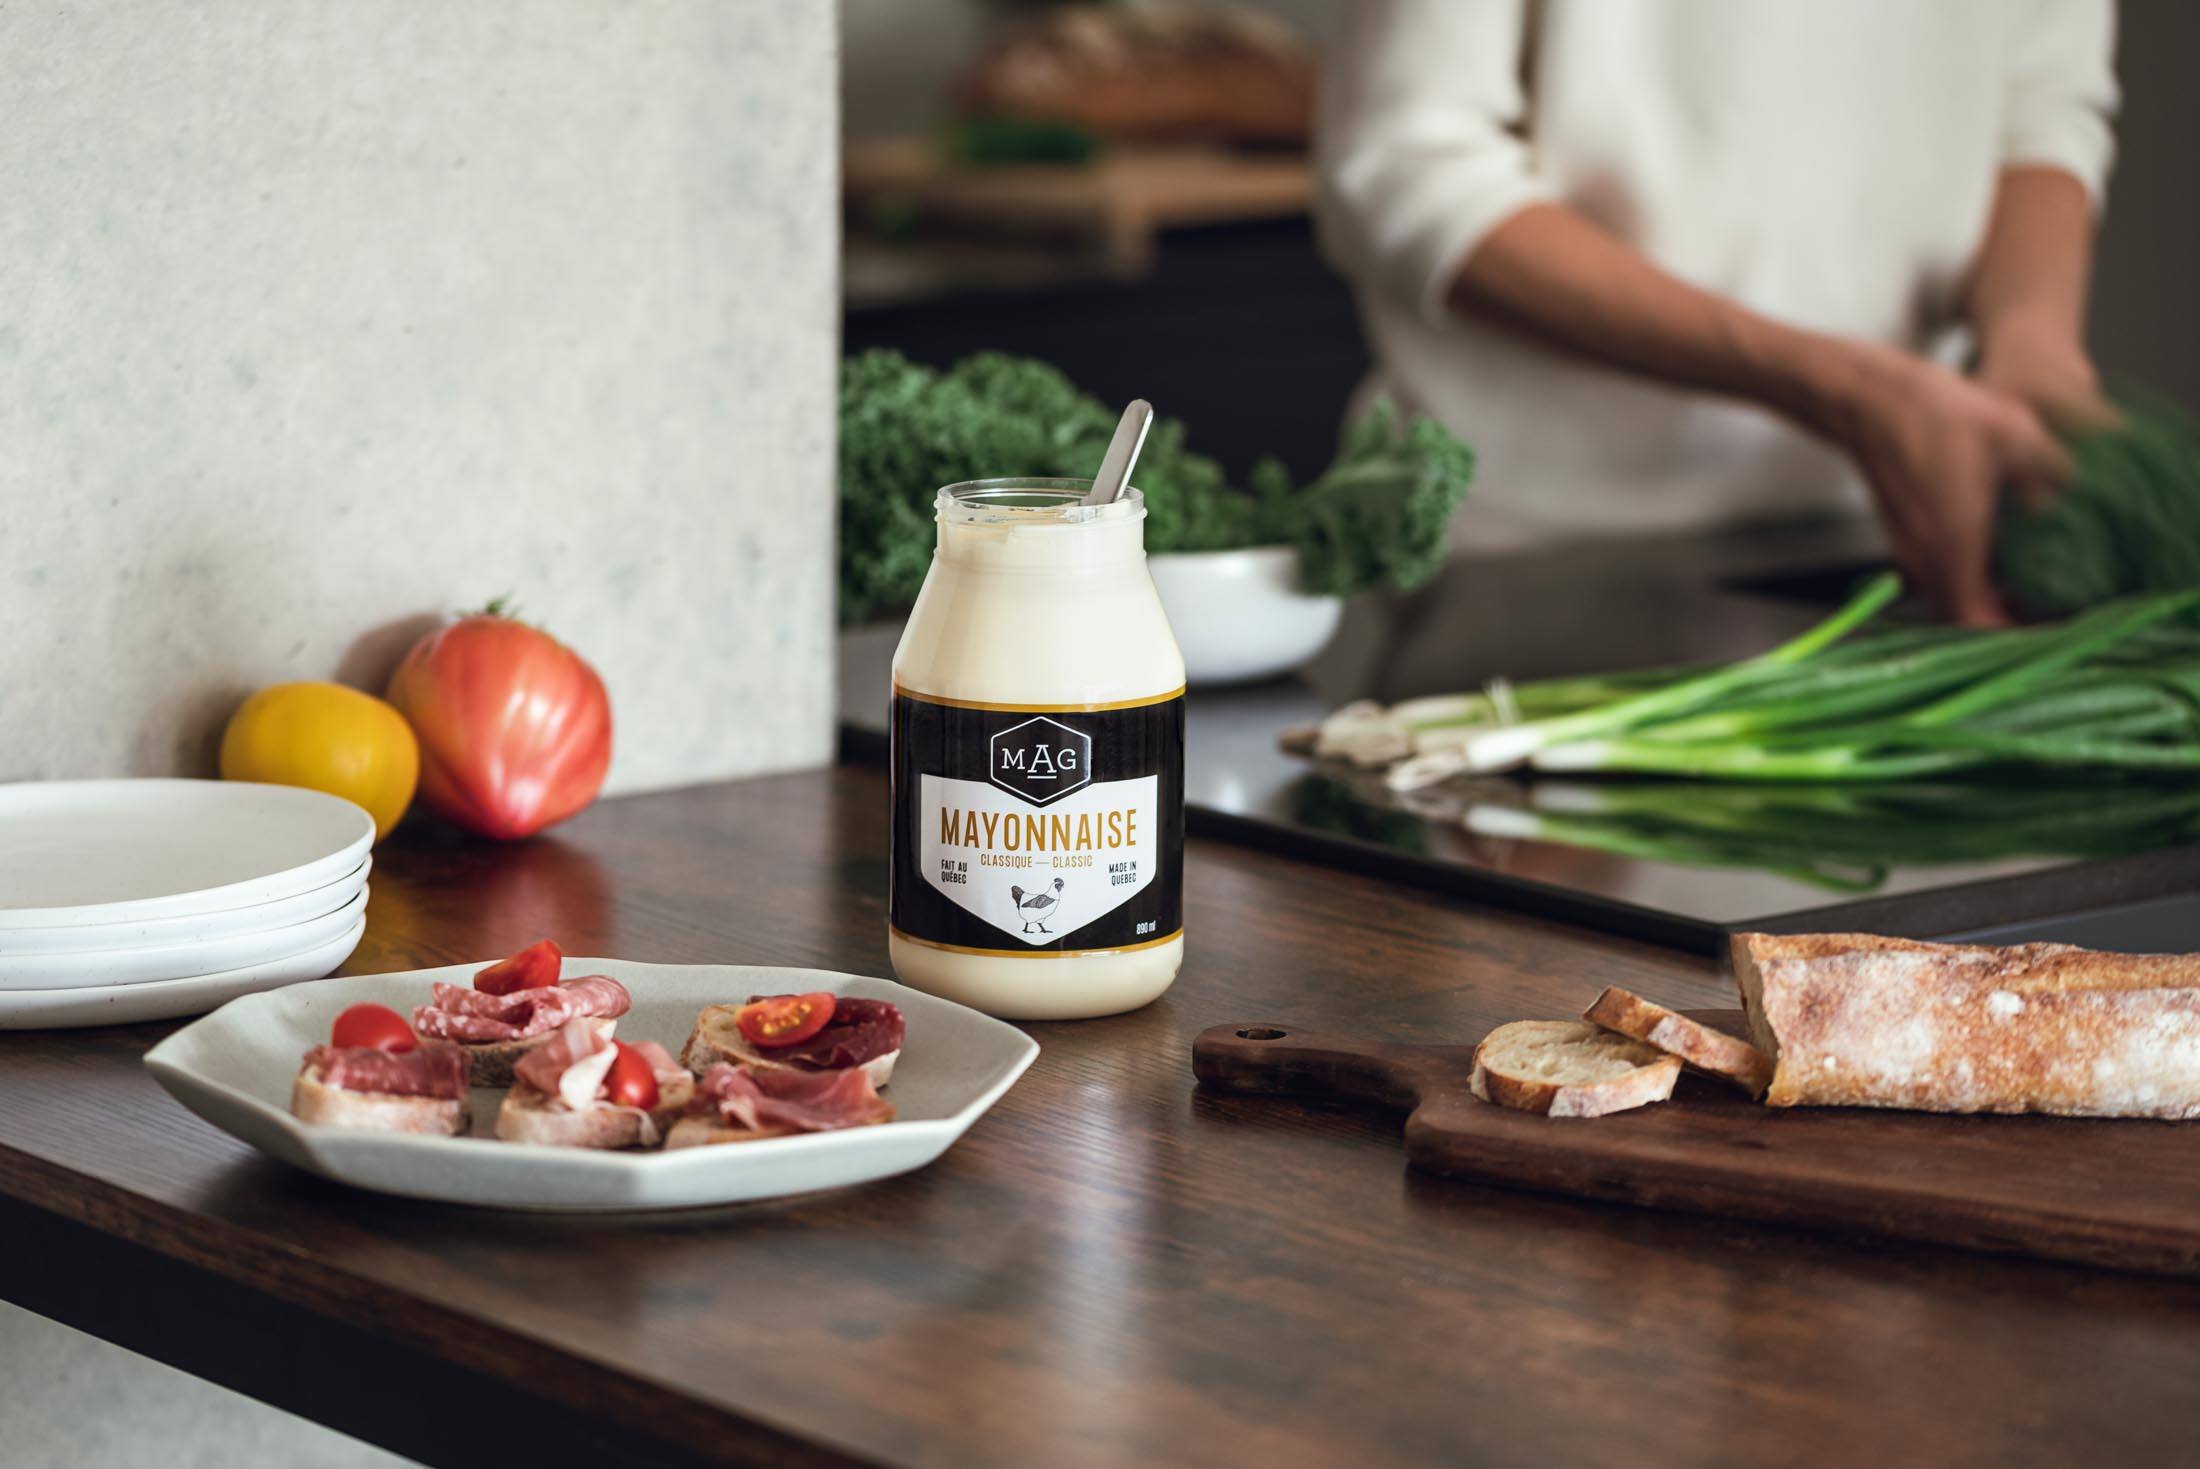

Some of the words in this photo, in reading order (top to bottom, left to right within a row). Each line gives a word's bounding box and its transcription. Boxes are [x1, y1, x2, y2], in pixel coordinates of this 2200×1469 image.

[1001, 744, 1077, 779] MAG
[941, 806, 1137, 852] MAYONNAISE
[941, 859, 955, 871] FAIT
[957, 861, 968, 872] AU
[980, 853, 1033, 868] CLASSIQUE
[1052, 855, 1093, 868] CLASSIC
[1108, 861, 1127, 873] MADE
[1129, 860, 1137, 871] IN
[1136, 921, 1148, 935] 890
